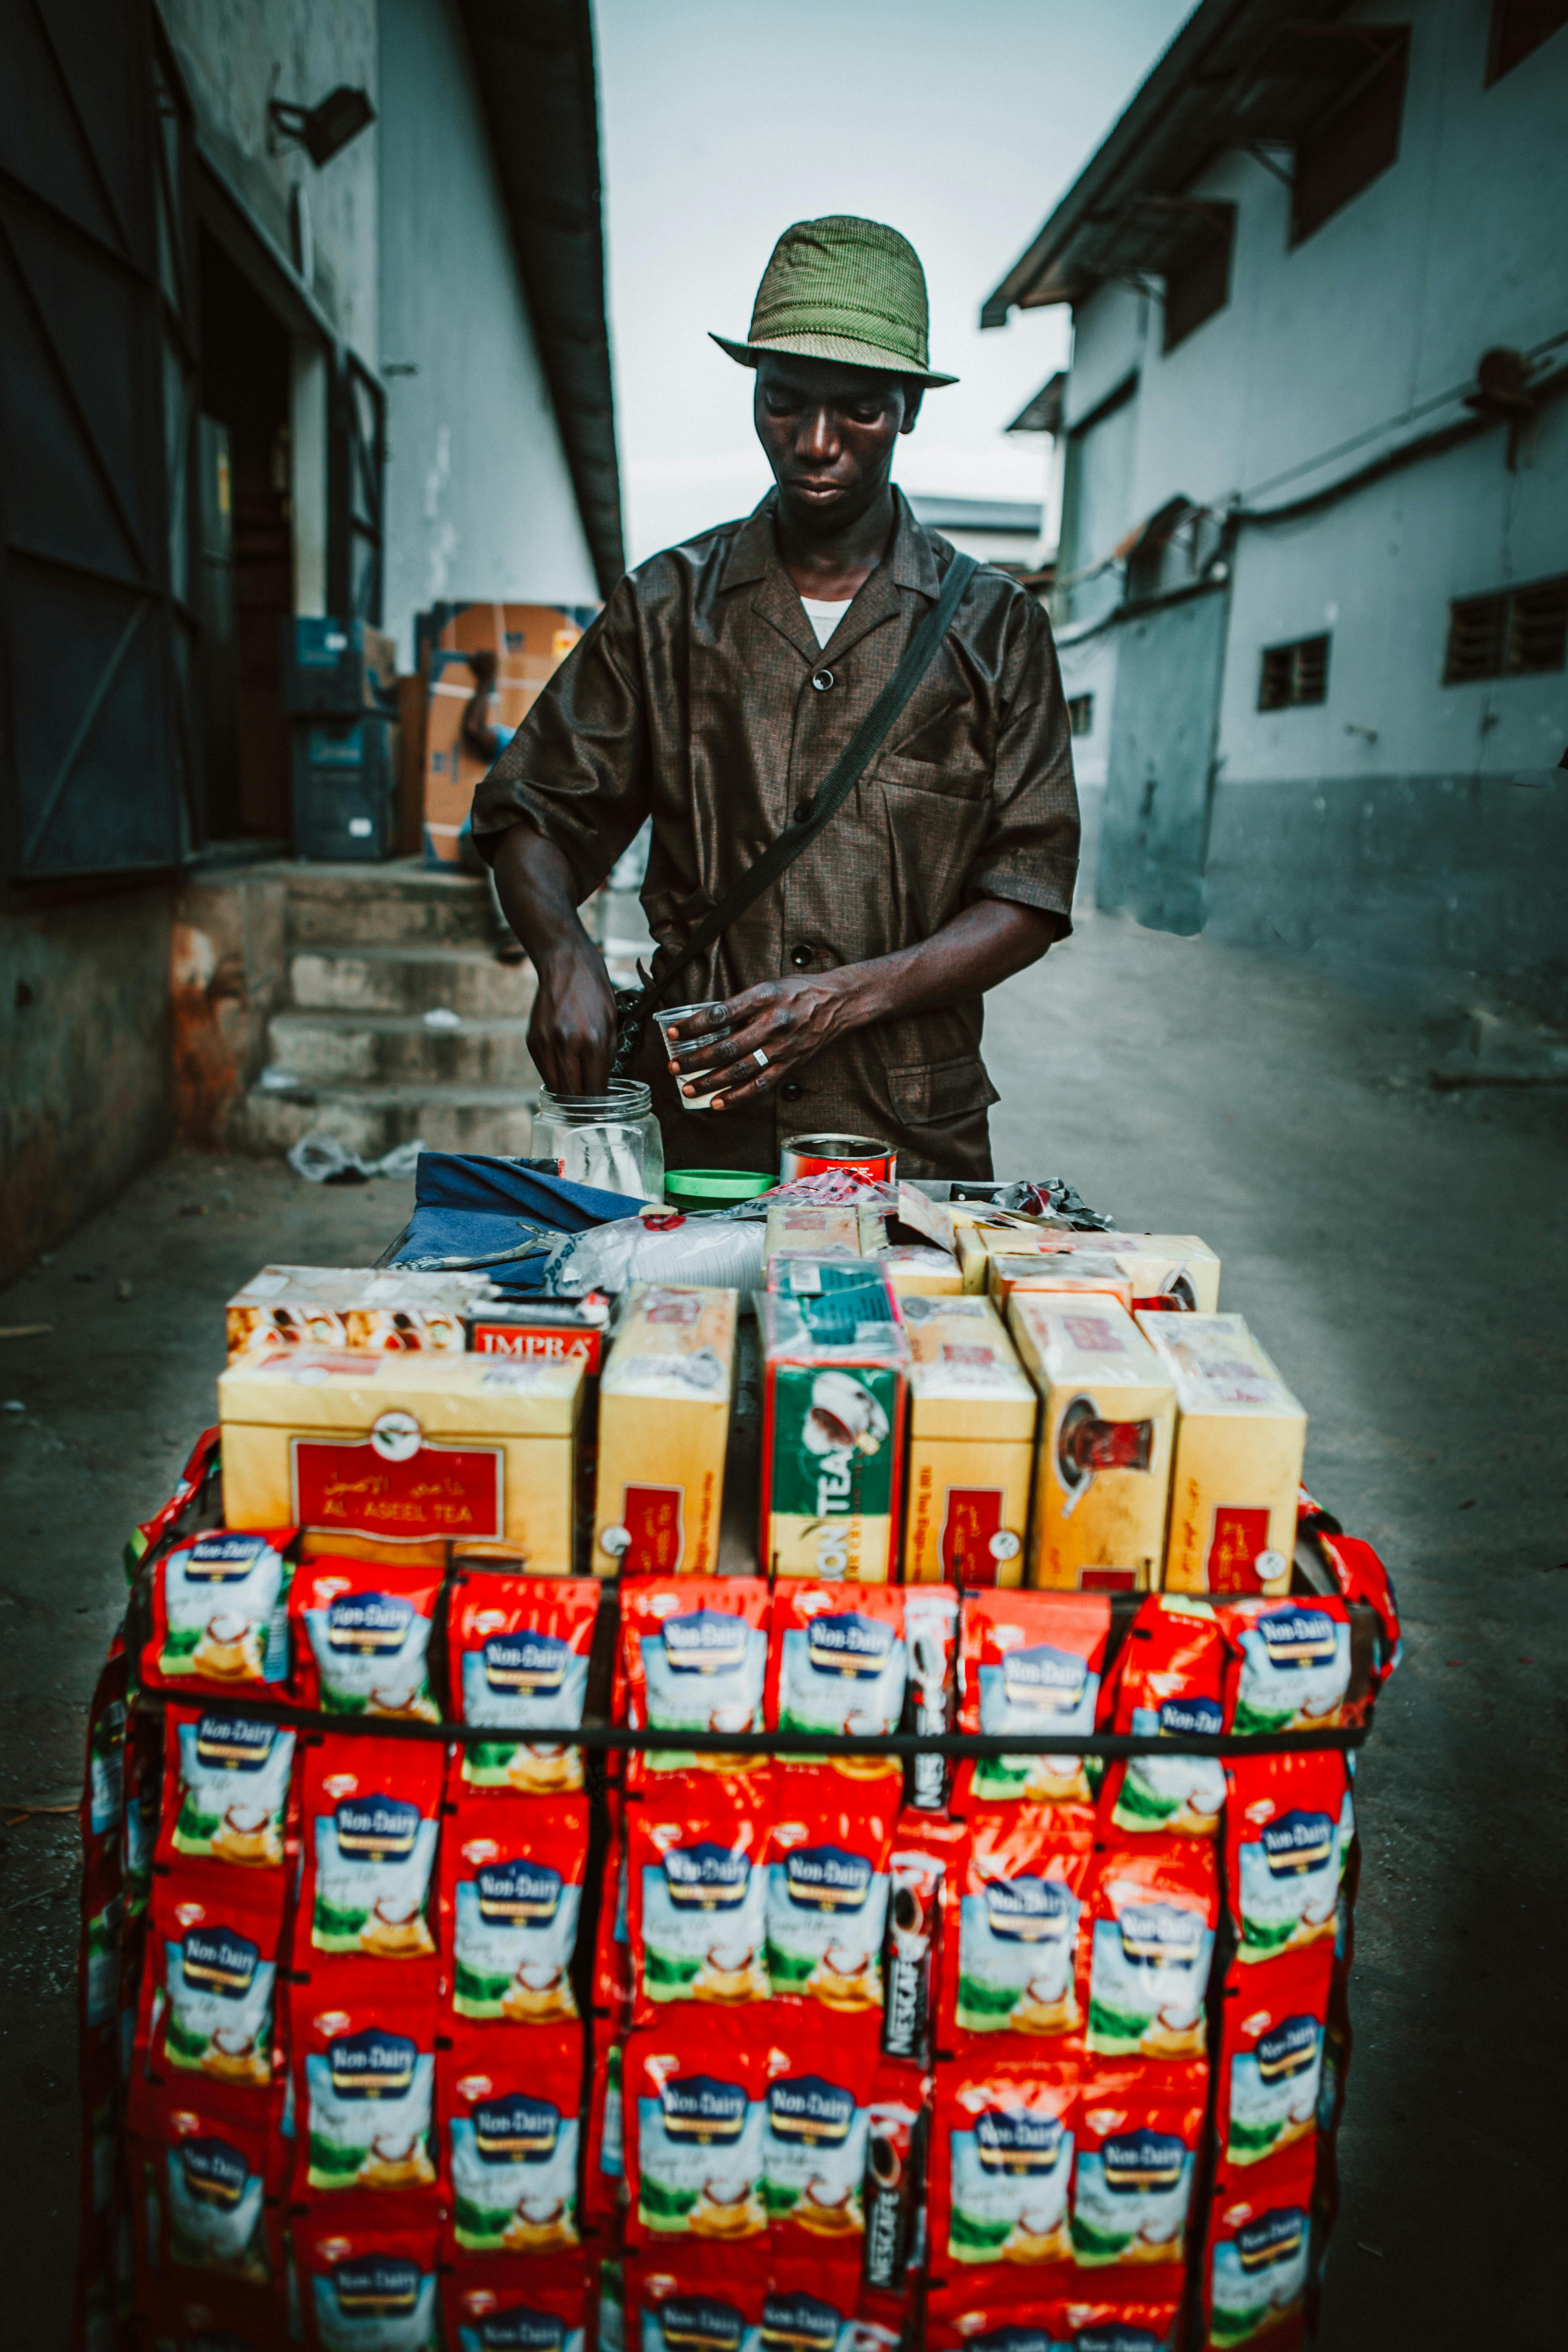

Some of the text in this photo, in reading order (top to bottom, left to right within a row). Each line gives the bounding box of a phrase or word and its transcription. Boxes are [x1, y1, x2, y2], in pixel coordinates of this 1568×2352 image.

[483, 1333, 590, 1358] IMPRA
[817, 1450, 853, 1518] TEA
[432, 1502, 473, 1523] TEA
[816, 1524, 849, 1582] ON
[813, 1625, 891, 1654] Non-Dairy
[1262, 1618, 1333, 1640] Non-Dairy
[487, 1643, 568, 1671] Non-Dairy
[201, 1719, 274, 1747] Non-Dairy
[339, 1809, 419, 1834] Non-Dairy
[789, 1858, 870, 1886] Non-Dairy
[479, 1874, 560, 1902] Non-Dairy
[187, 1937, 255, 1973] Non-Dairy
[333, 2046, 413, 2071] Non-Dairy
[663, 2093, 745, 2118] Non-Dairy
[773, 2089, 852, 2119] Non-Dairy
[477, 2111, 556, 2134] Non-Dairy
